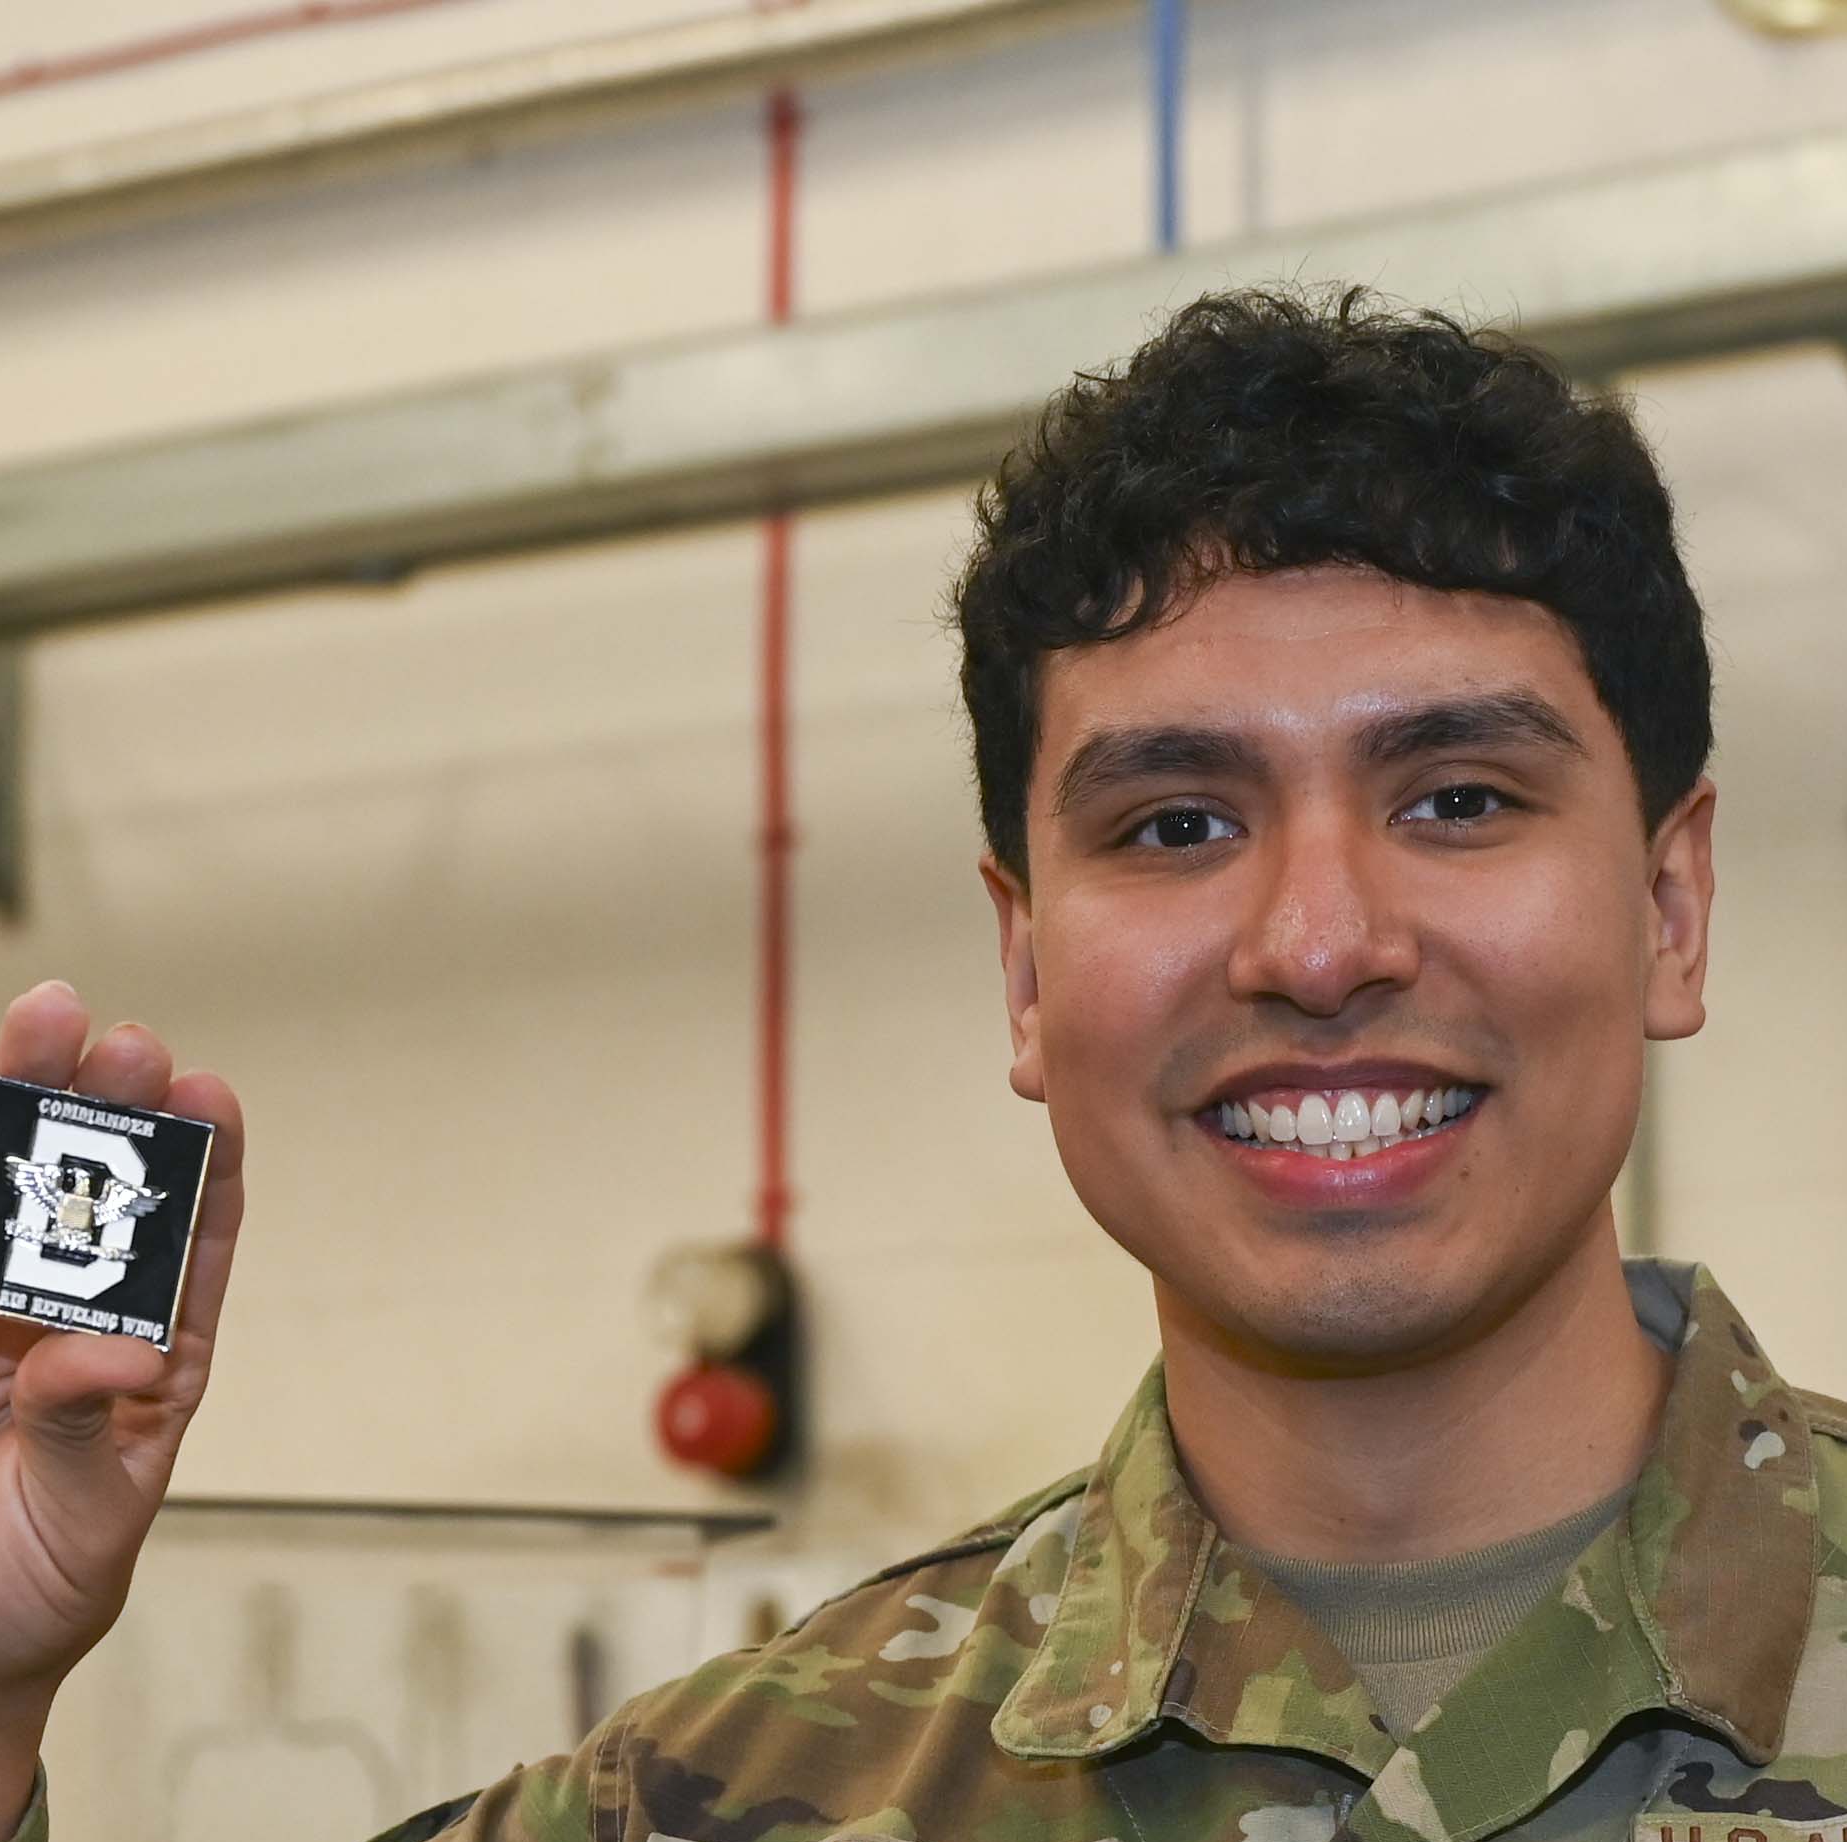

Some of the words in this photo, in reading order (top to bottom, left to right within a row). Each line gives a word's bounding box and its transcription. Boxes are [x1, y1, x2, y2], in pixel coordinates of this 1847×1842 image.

[38, 1097, 157, 1139] COMMANDER
[30, 1291, 120, 1334] REFUELING
[121, 1315, 166, 1343] WING
